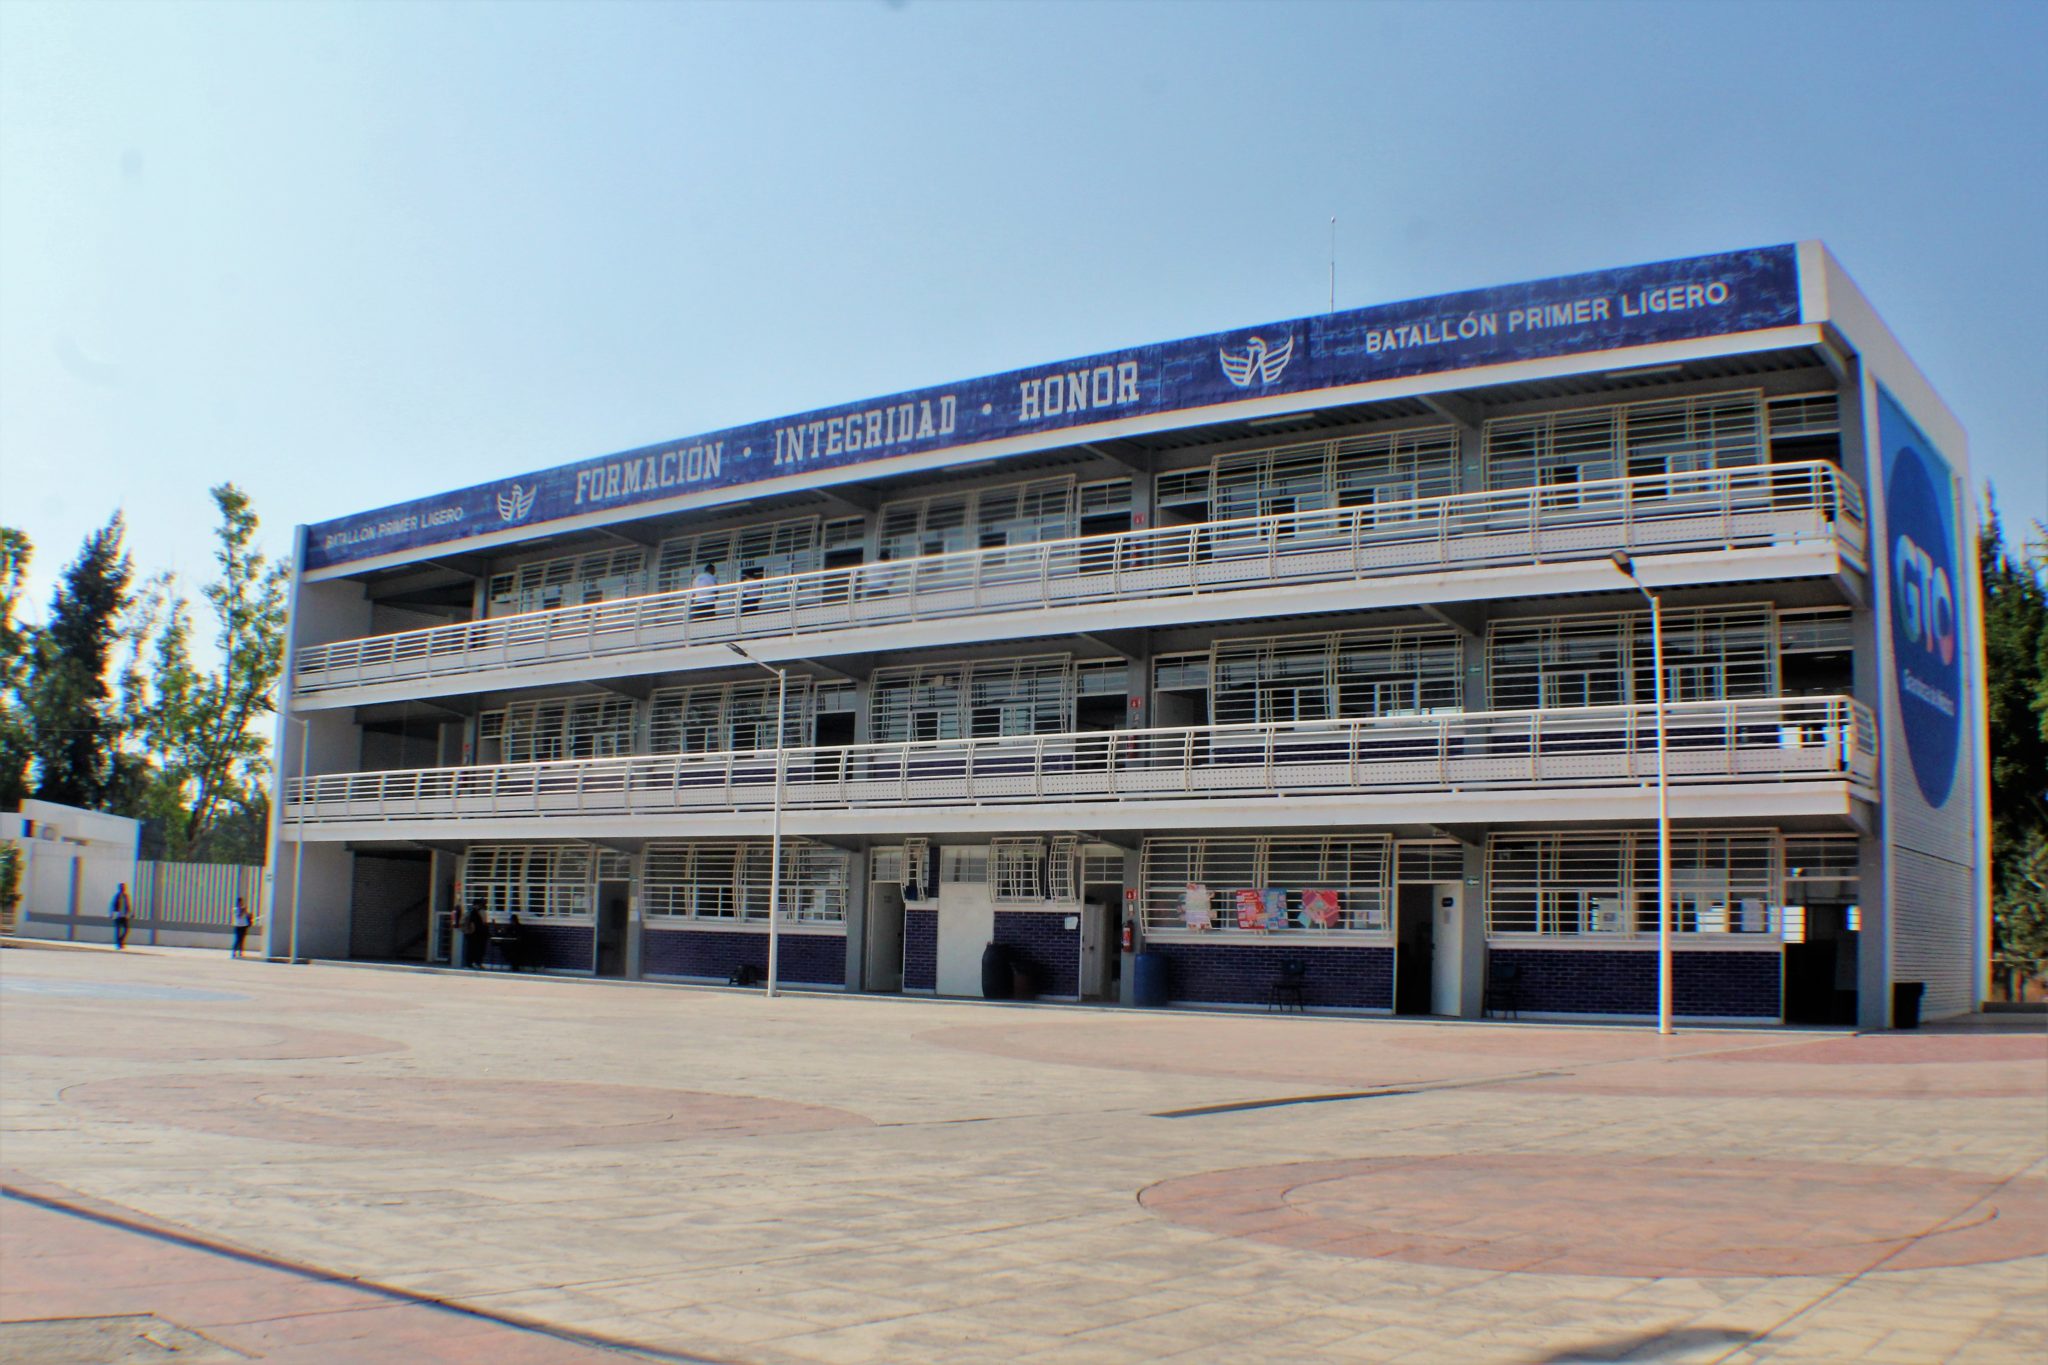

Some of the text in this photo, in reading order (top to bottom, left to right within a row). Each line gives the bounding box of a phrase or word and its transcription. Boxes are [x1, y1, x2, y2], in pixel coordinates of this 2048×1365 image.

[1366, 282, 1729, 354] BATALLÓN PRIMER LIGERO
[574, 361, 1140, 505] FORMACIÓN INTEGRIDAD HONOR
[377, 516, 418, 537] PRIMER
[420, 506, 464, 529] LIGERO
[1895, 534, 1954, 666] GTO
